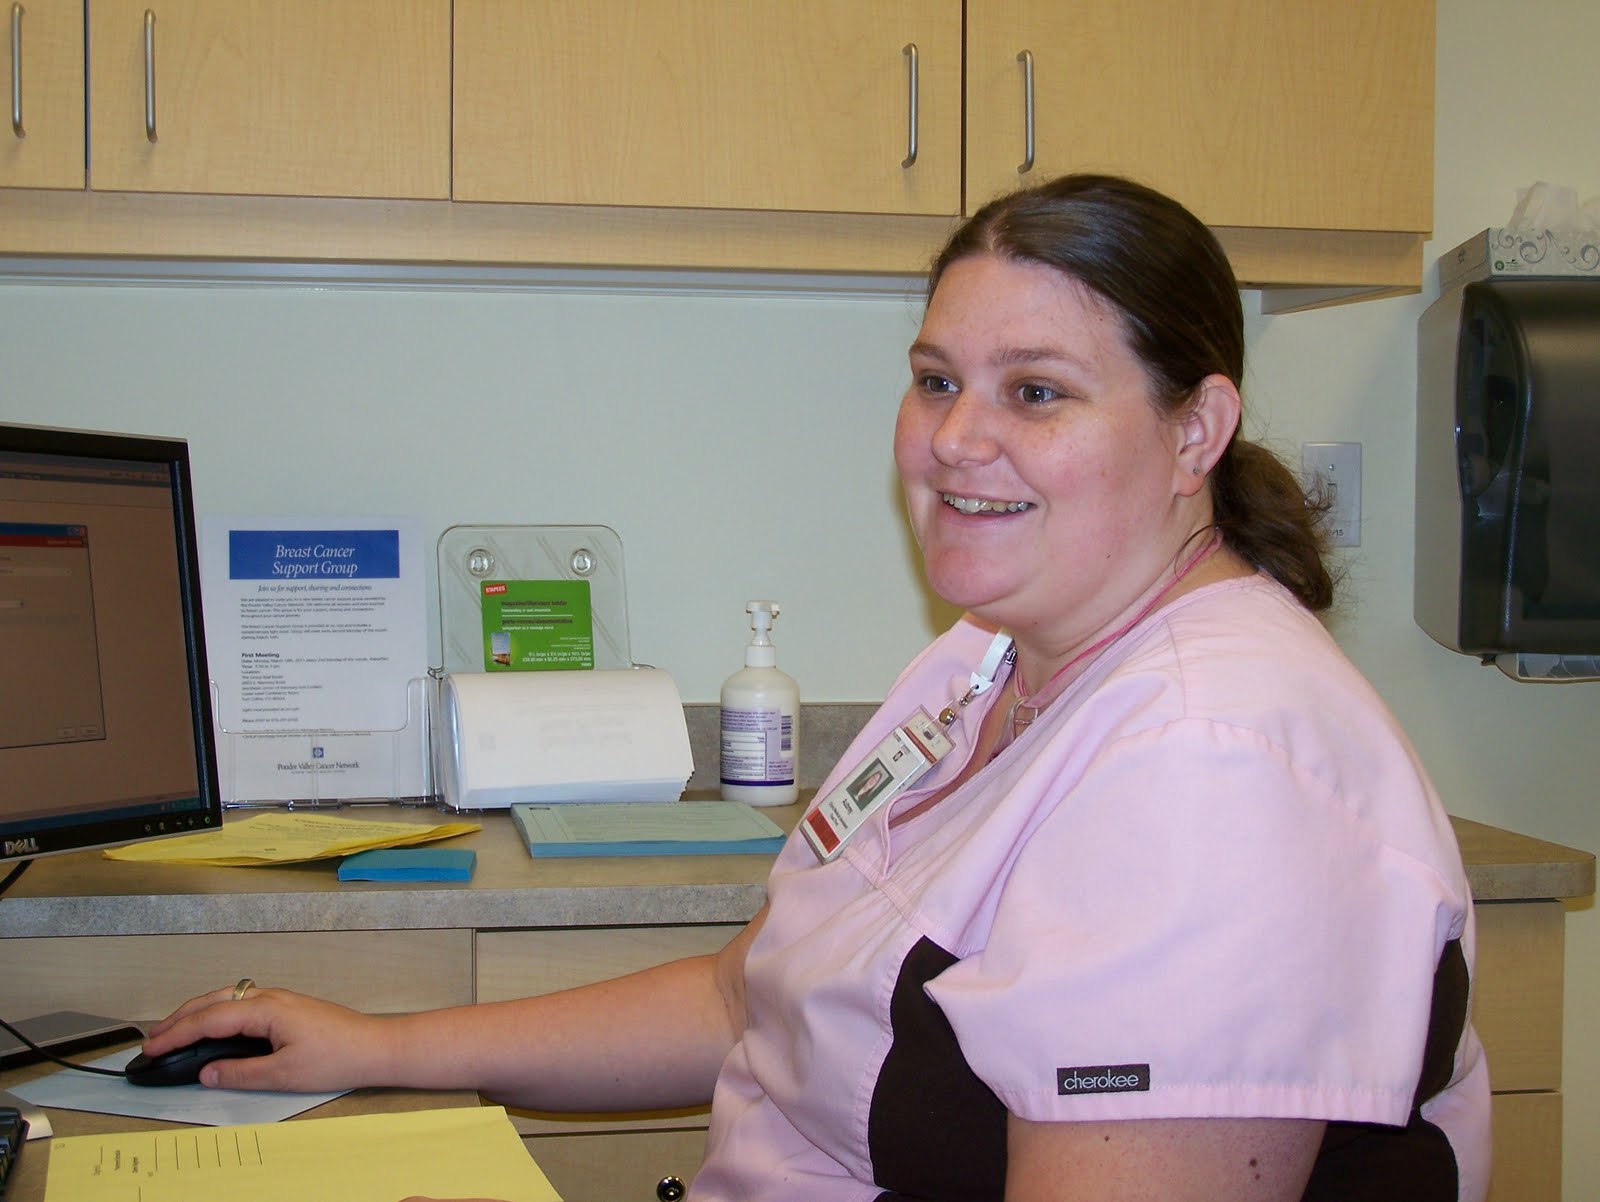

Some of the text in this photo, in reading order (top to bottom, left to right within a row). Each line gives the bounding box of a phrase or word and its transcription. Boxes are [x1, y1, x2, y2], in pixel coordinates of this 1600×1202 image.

[275, 544, 355, 558] Breast Cancer
[272, 561, 358, 578] Support Group
[485, 585, 506, 594] STAPLES
[336, 760, 360, 769] Network
[5, 837, 39, 856] DELL
[1064, 1069, 1139, 1091] cherokee
